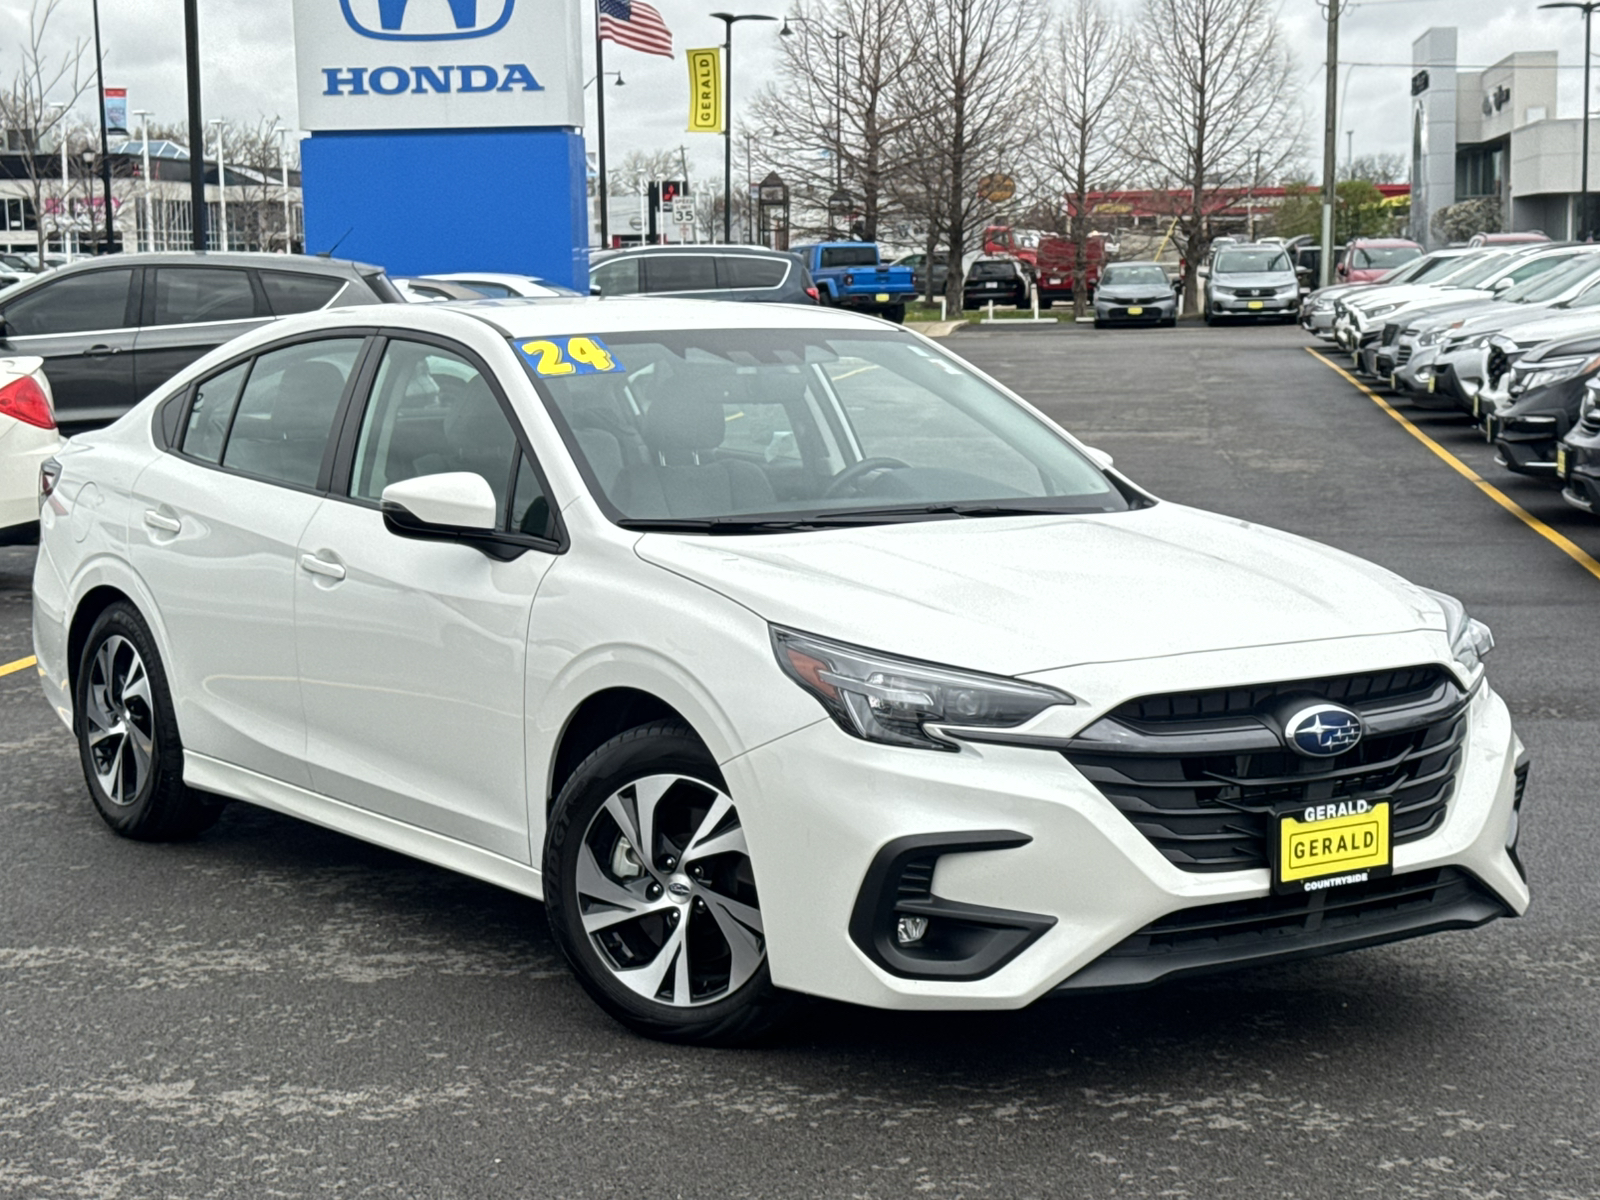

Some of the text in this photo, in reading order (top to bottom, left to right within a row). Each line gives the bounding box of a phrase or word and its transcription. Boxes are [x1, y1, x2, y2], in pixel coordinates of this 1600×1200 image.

[321, 63, 545, 96] HONDA
[699, 59, 711, 122] GERALD
[676, 210, 694, 222] 35
[521, 337, 615, 376] 24
[1304, 799, 1368, 822] GERALD
[1294, 830, 1374, 859] GERALD
[1304, 872, 1368, 891] COUNTRYSIDE
